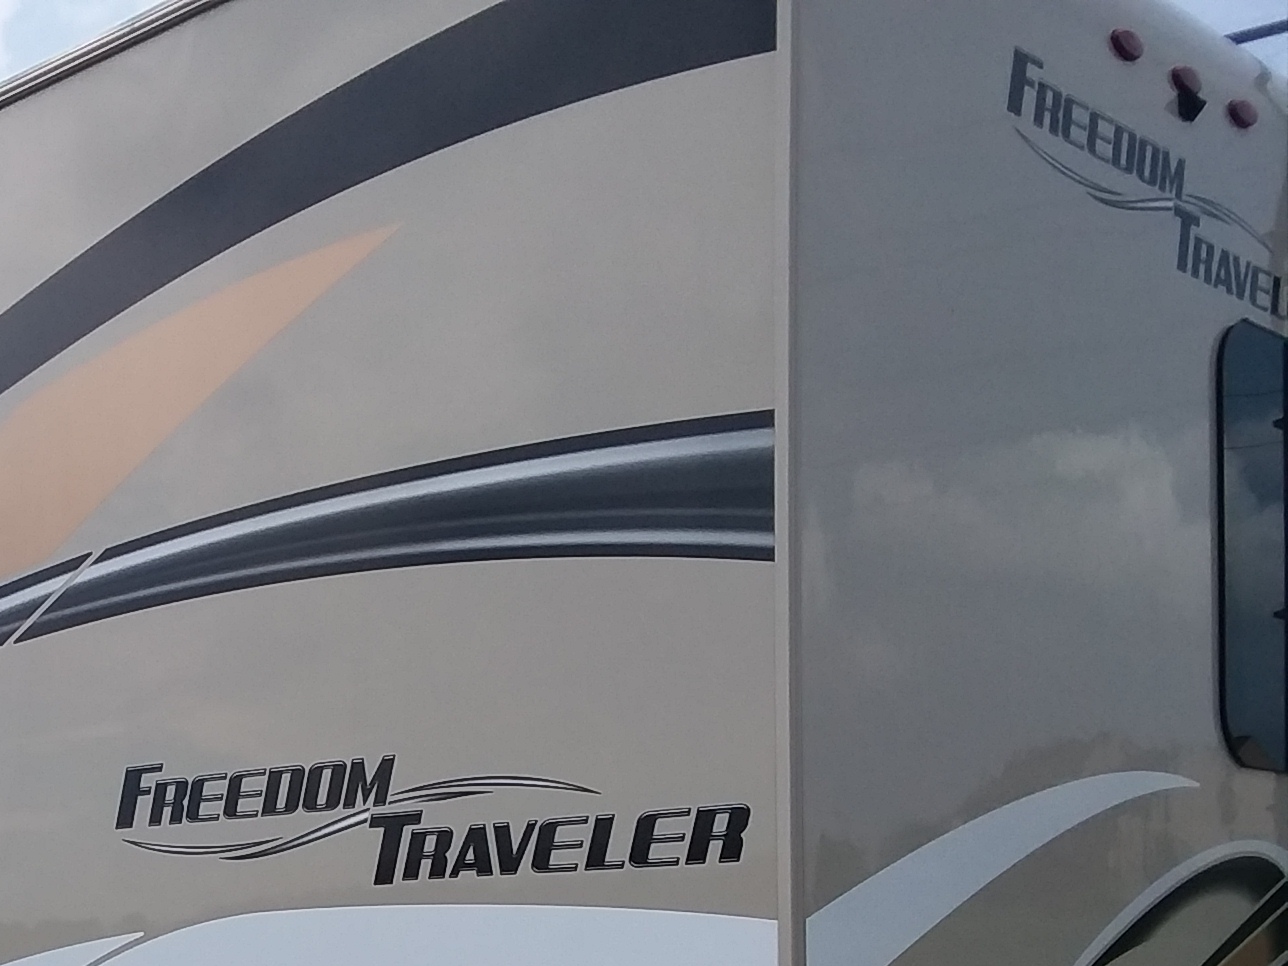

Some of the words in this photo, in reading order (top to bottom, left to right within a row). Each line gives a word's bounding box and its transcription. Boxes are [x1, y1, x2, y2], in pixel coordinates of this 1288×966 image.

[1006, 46, 1186, 201] FREEDOM
[1173, 204, 1288, 319] TRAVEL
[114, 754, 396, 829] FREEDOM
[368, 804, 751, 886] TRAVELER
